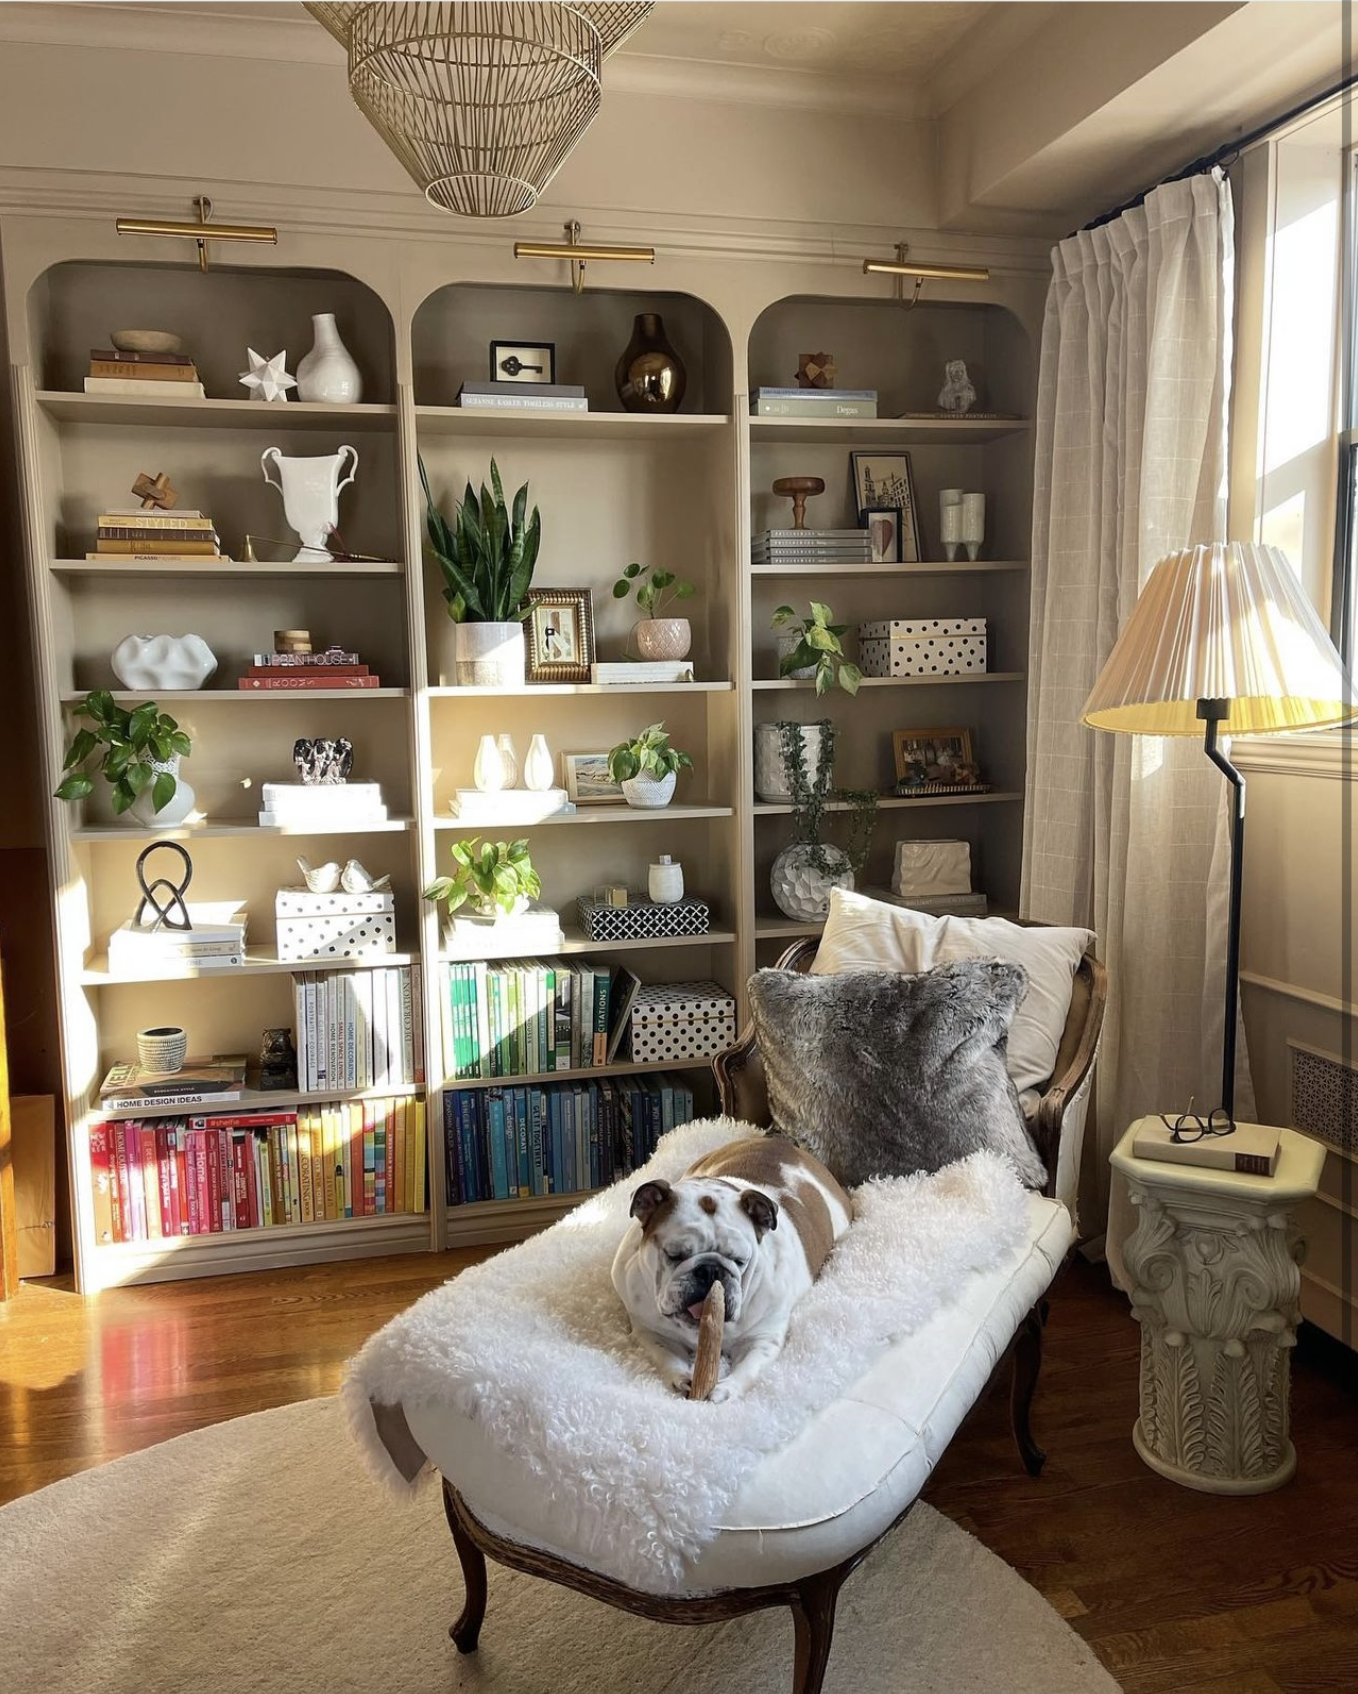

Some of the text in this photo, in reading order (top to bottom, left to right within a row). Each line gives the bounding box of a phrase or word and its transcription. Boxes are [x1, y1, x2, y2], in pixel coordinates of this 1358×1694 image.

[134, 518, 188, 528] STYLED
[272, 679, 315, 688] ROOMS
[403, 982, 412, 1042] DECORATION
[598, 990, 607, 1033] CITATIONS
[116, 1096, 202, 1108] HOME DESIGN IDEAS
[532, 1105, 540, 1118] GET
[210, 1118, 240, 1127] #shelfie
[461, 1100, 470, 1130] SINGER
[506, 1115, 514, 1140] design
[116, 1132, 126, 1153] HOME
[518, 1118, 527, 1154] DECORATE
[196, 1152, 206, 1182] Home
[188, 1166, 196, 1199] decorating
